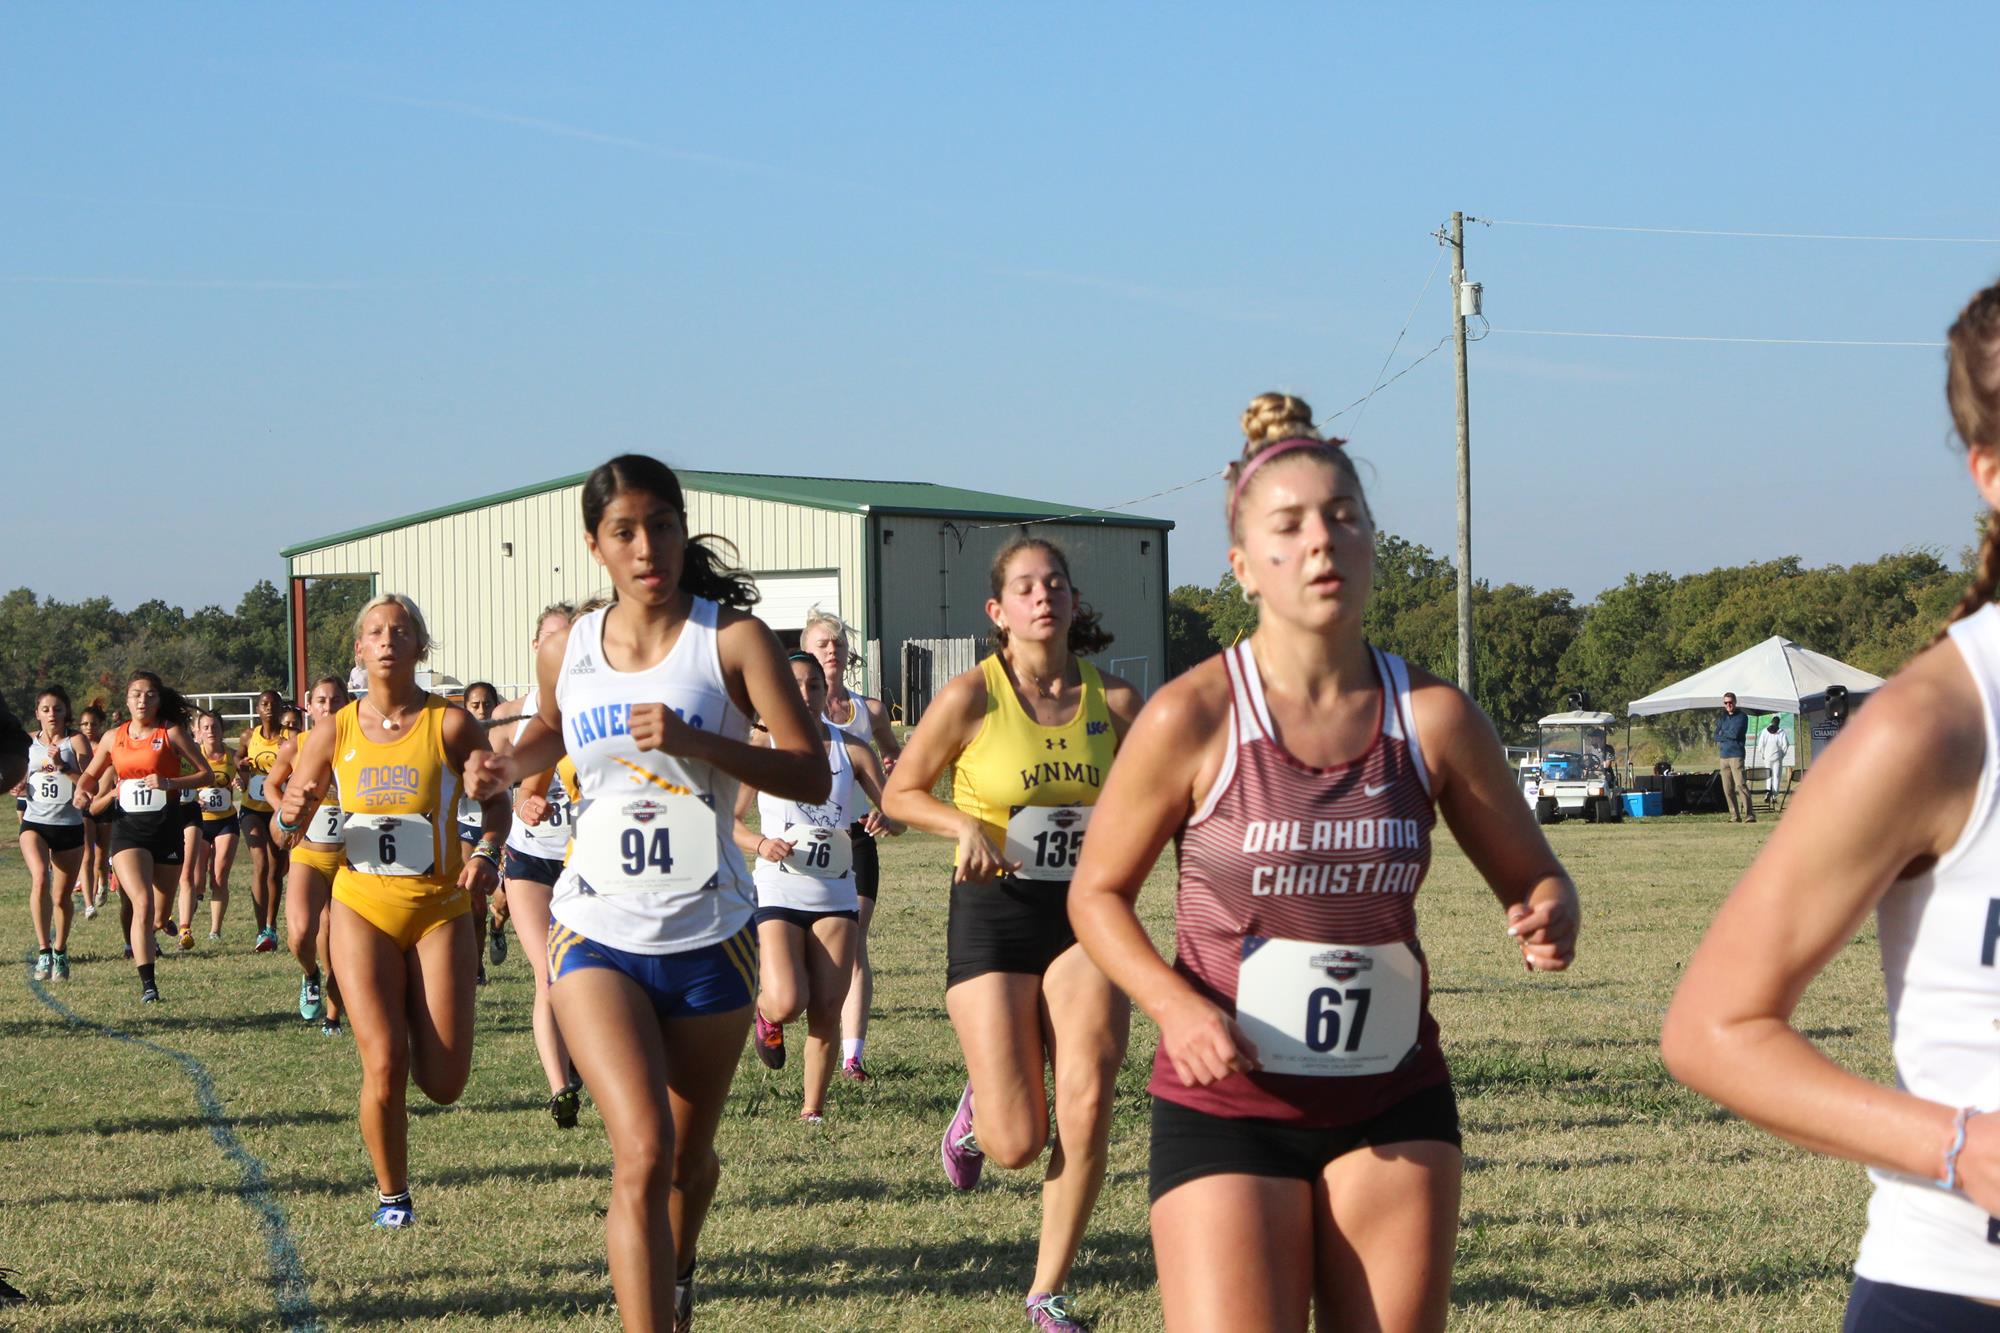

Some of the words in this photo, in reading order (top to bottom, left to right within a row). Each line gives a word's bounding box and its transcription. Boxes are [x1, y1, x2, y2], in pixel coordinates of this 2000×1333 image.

[1021, 762, 1099, 790] WNMU
[41, 783, 58, 798] 59
[133, 790, 152, 805] 117
[210, 795, 222, 807] 83
[366, 792, 409, 806] STATE
[379, 833, 396, 864] 6
[1242, 819, 1419, 853] OKLAHOMA
[621, 828, 673, 876] 94
[806, 841, 831, 868] 76
[1252, 863, 1420, 897] CHRISTIAN
[1306, 987, 1371, 1053] 67
